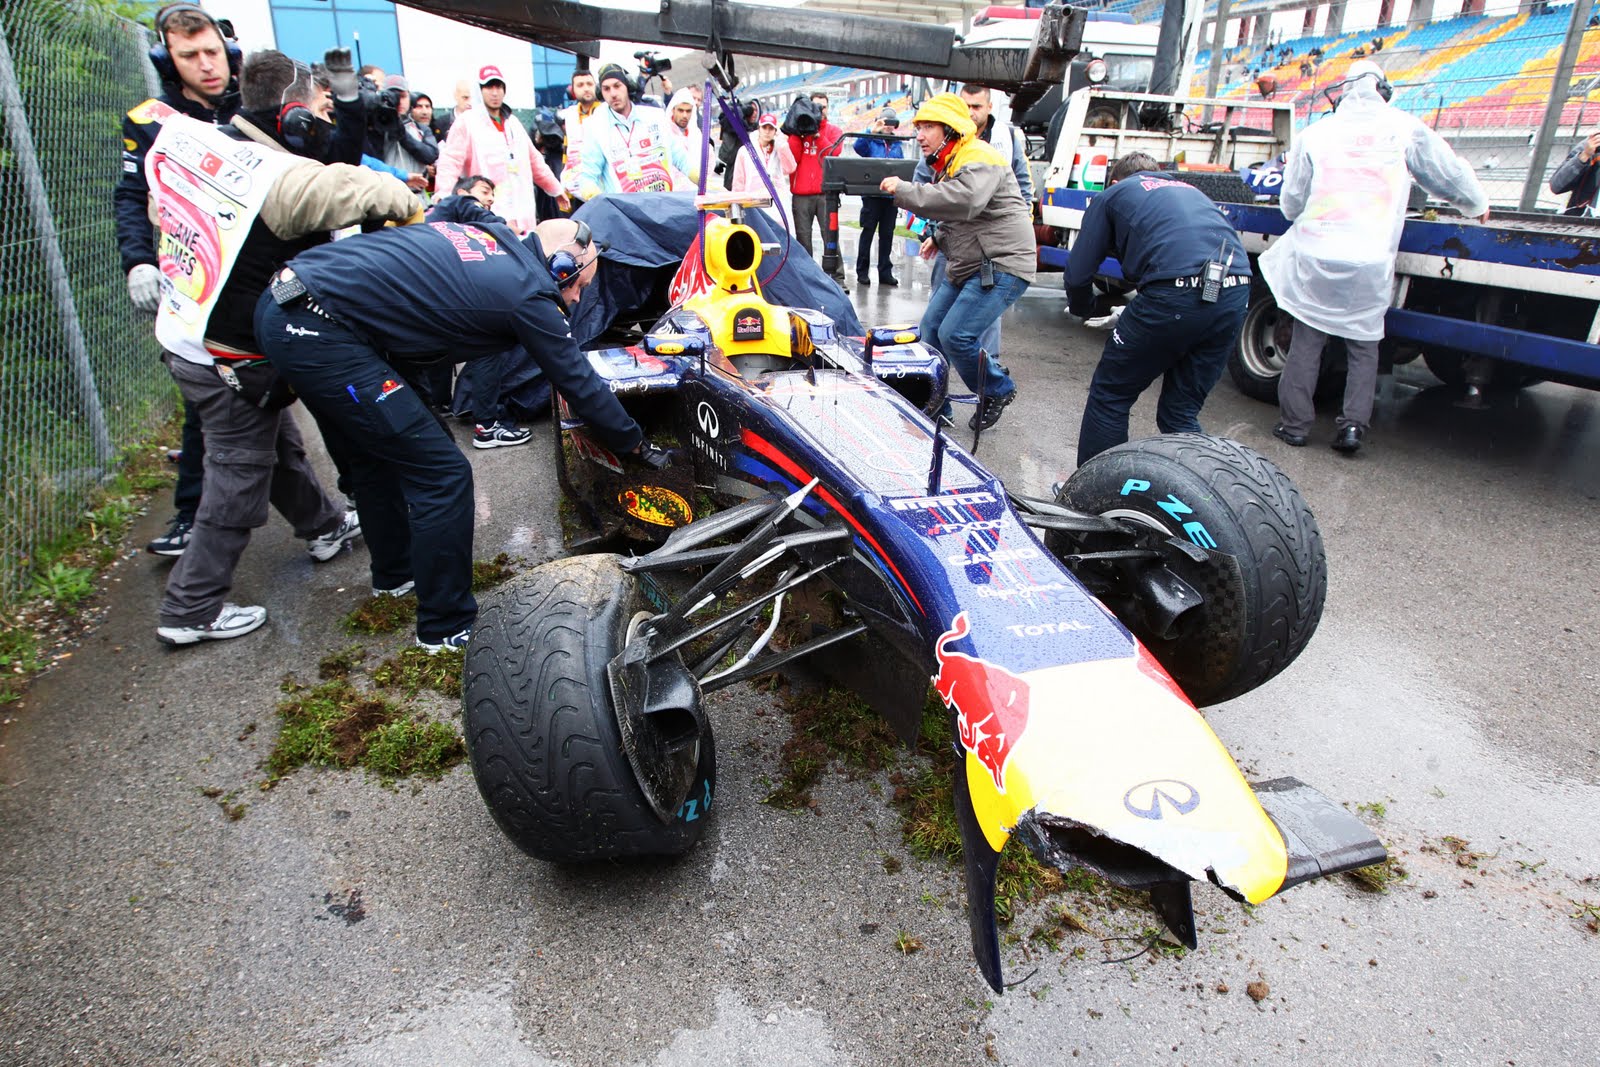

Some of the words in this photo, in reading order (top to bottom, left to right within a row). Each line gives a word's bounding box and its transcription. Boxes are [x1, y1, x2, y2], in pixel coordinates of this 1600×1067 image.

[690, 432, 727, 471] INFINITI
[1120, 478, 1151, 496] P
[1156, 494, 1218, 550] ZE
[948, 547, 1040, 566] CASIO
[1005, 619, 1093, 638] TOTAL
